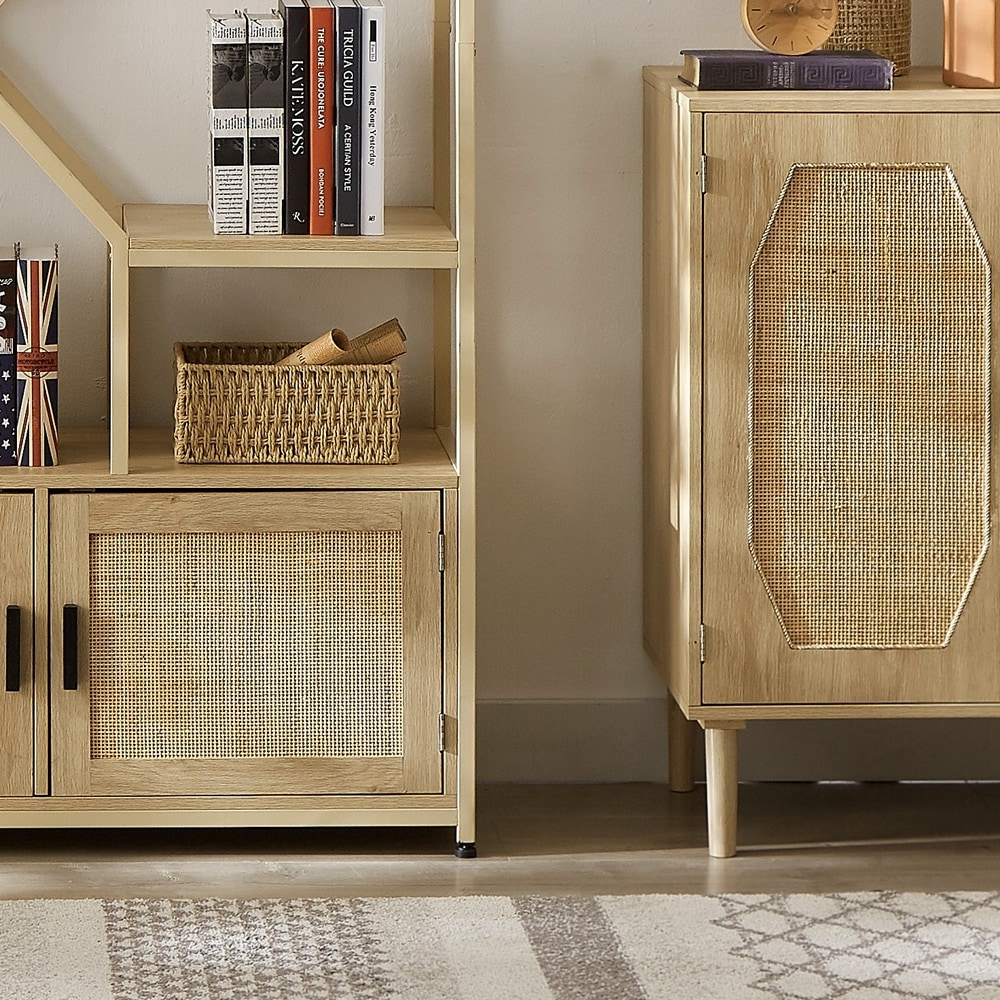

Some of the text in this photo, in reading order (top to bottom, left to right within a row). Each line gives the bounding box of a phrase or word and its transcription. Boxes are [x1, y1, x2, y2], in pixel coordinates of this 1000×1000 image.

[344, 28, 354, 106] TRICIA GUILD
[368, 85, 377, 166] Hong Kong Yesterday
